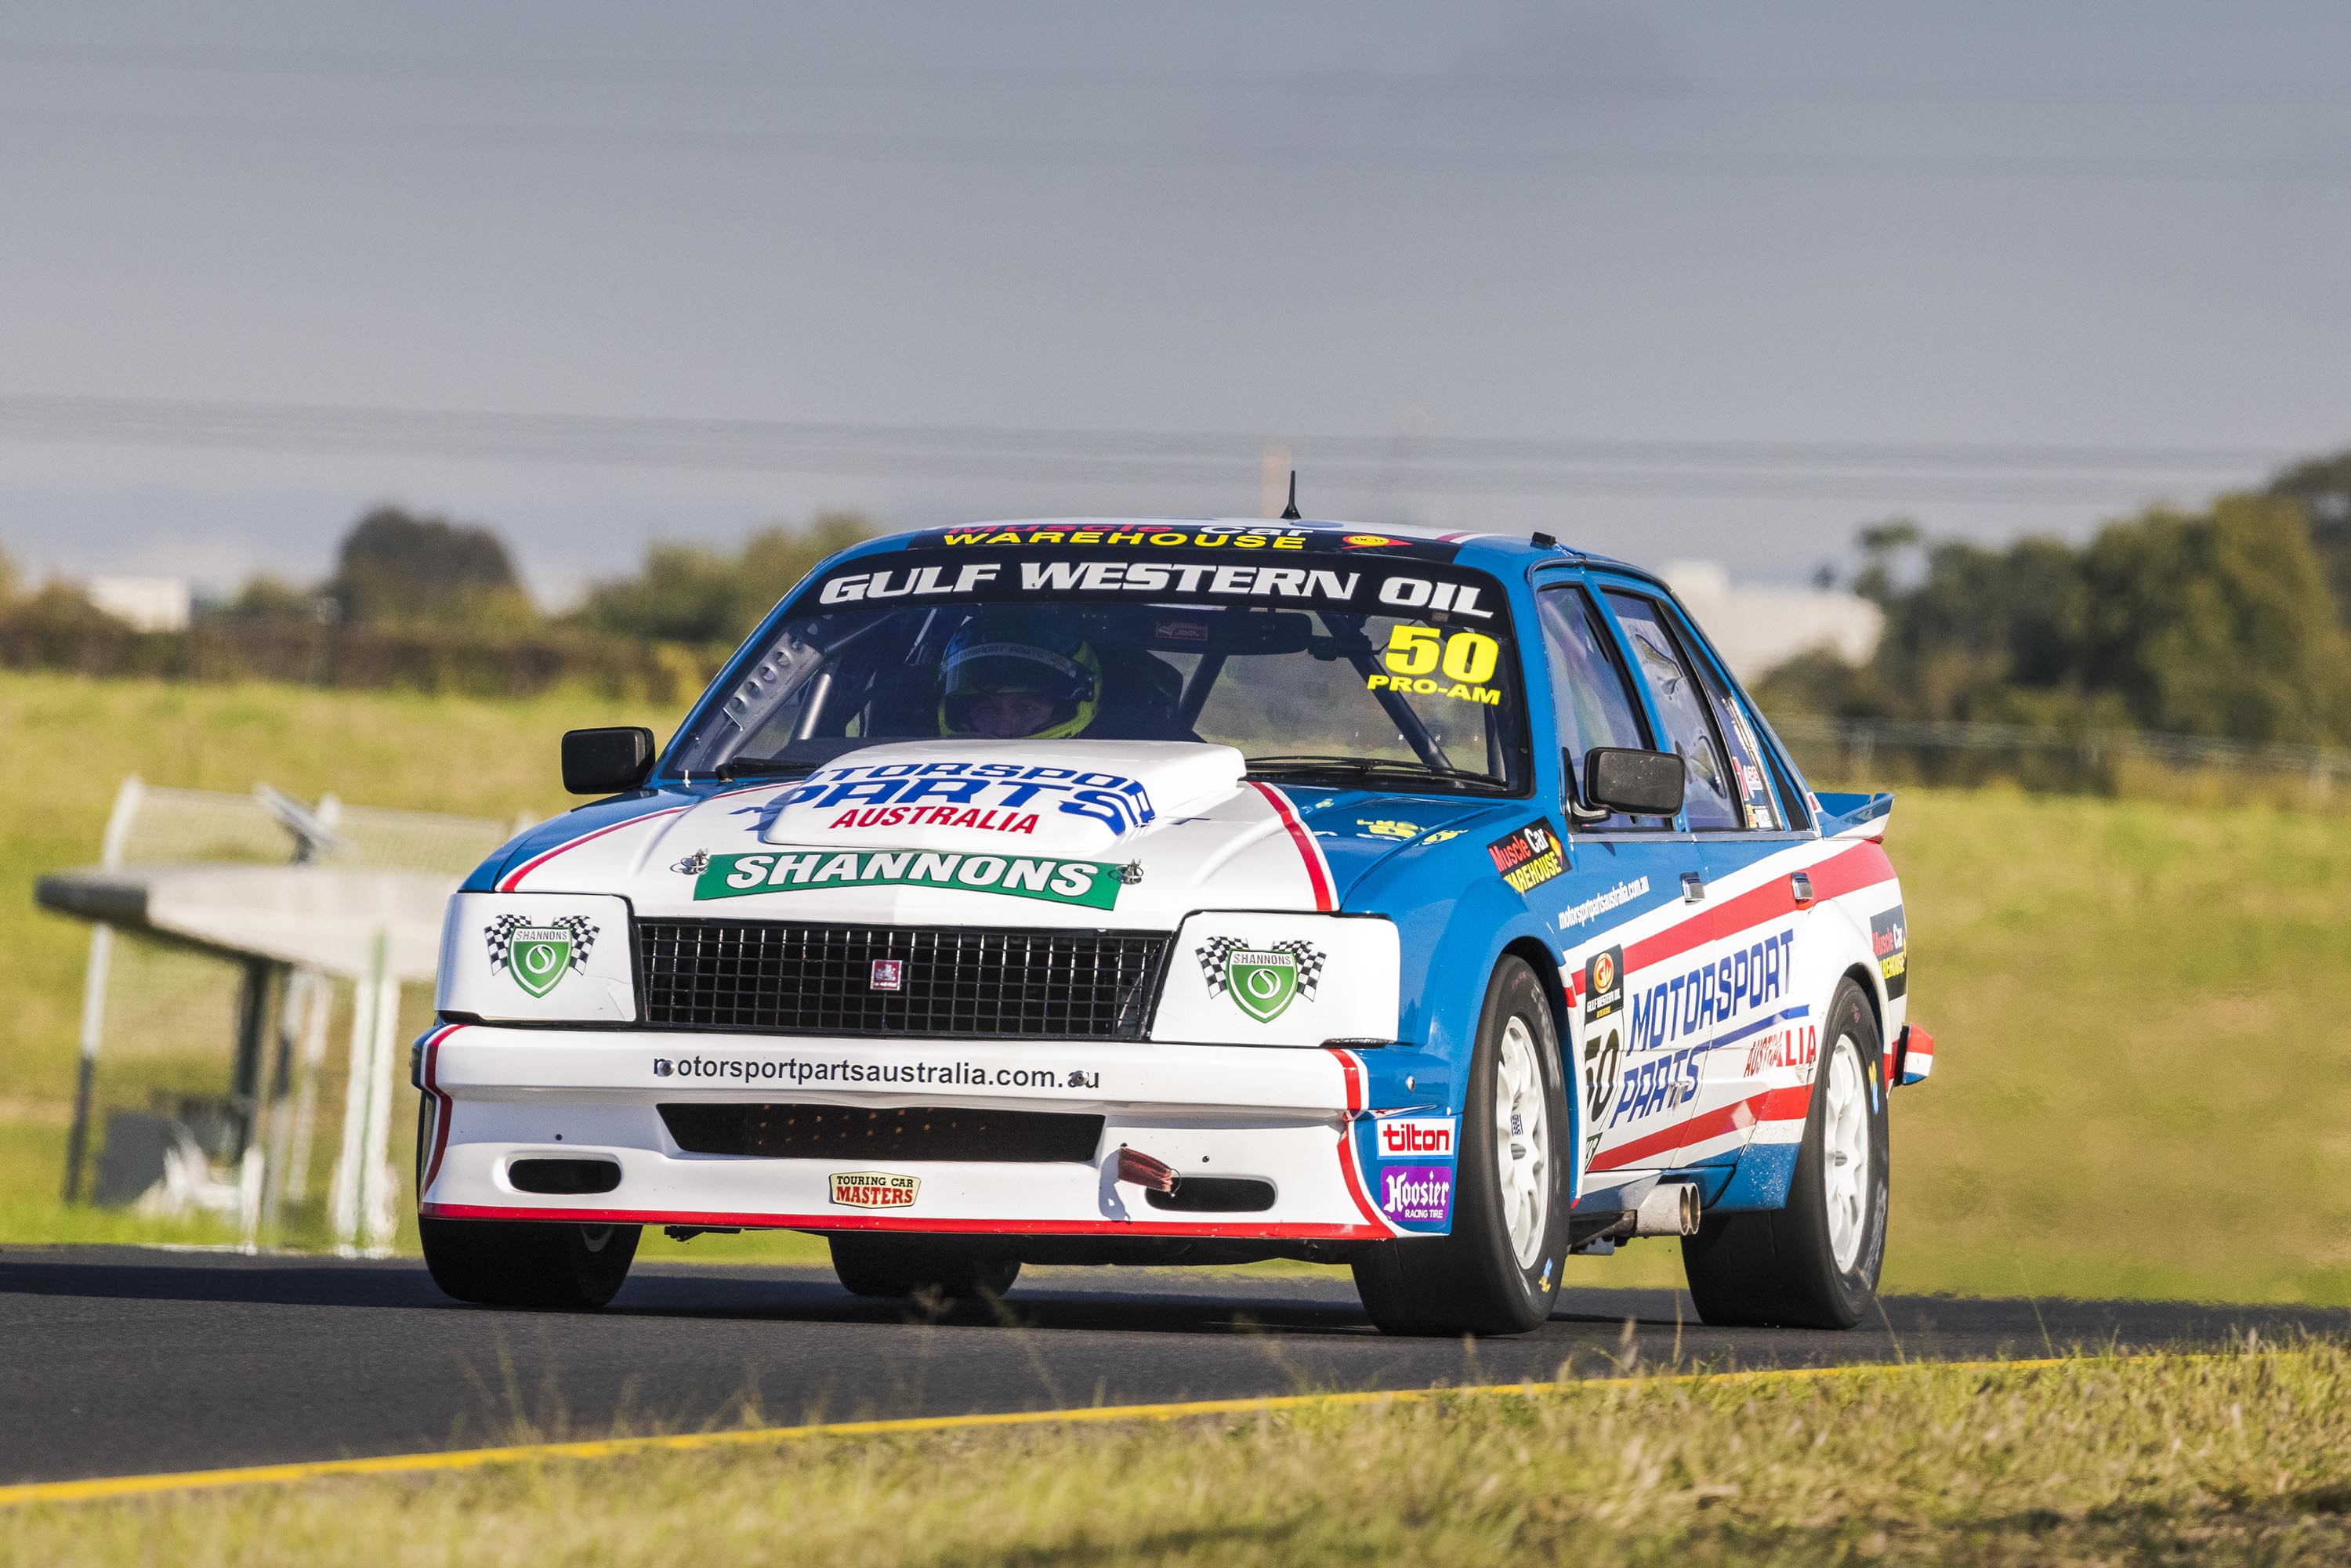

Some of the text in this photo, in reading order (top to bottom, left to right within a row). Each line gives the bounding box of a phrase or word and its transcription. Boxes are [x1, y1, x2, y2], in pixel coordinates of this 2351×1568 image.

[944, 532, 1306, 549] WAREHOUSE
[1200, 526, 1313, 536] Car
[820, 561, 1494, 618] GULF WESTERN OIL
[1385, 625, 1499, 684] 50
[1367, 674, 1502, 706] PRO-AM
[744, 778, 1127, 837] PARTS
[828, 806, 1040, 834] AUSTRALIA
[1489, 827, 1549, 872] Muscle Car
[726, 851, 1099, 897] SHANNONS
[516, 930, 567, 940] SHANNONS
[1233, 953, 1292, 965] SHANNONS
[1625, 928, 1794, 1057] MOTORSPORT
[1609, 1042, 1701, 1129] PARTS
[1383, 1124, 1450, 1151] tilton
[835, 1186, 913, 1204] MASTERS
[836, 1175, 913, 1187] TOURING CAR
[1383, 1170, 1450, 1213] Hoosier
[1404, 1209, 1444, 1219] RACING TIRE
